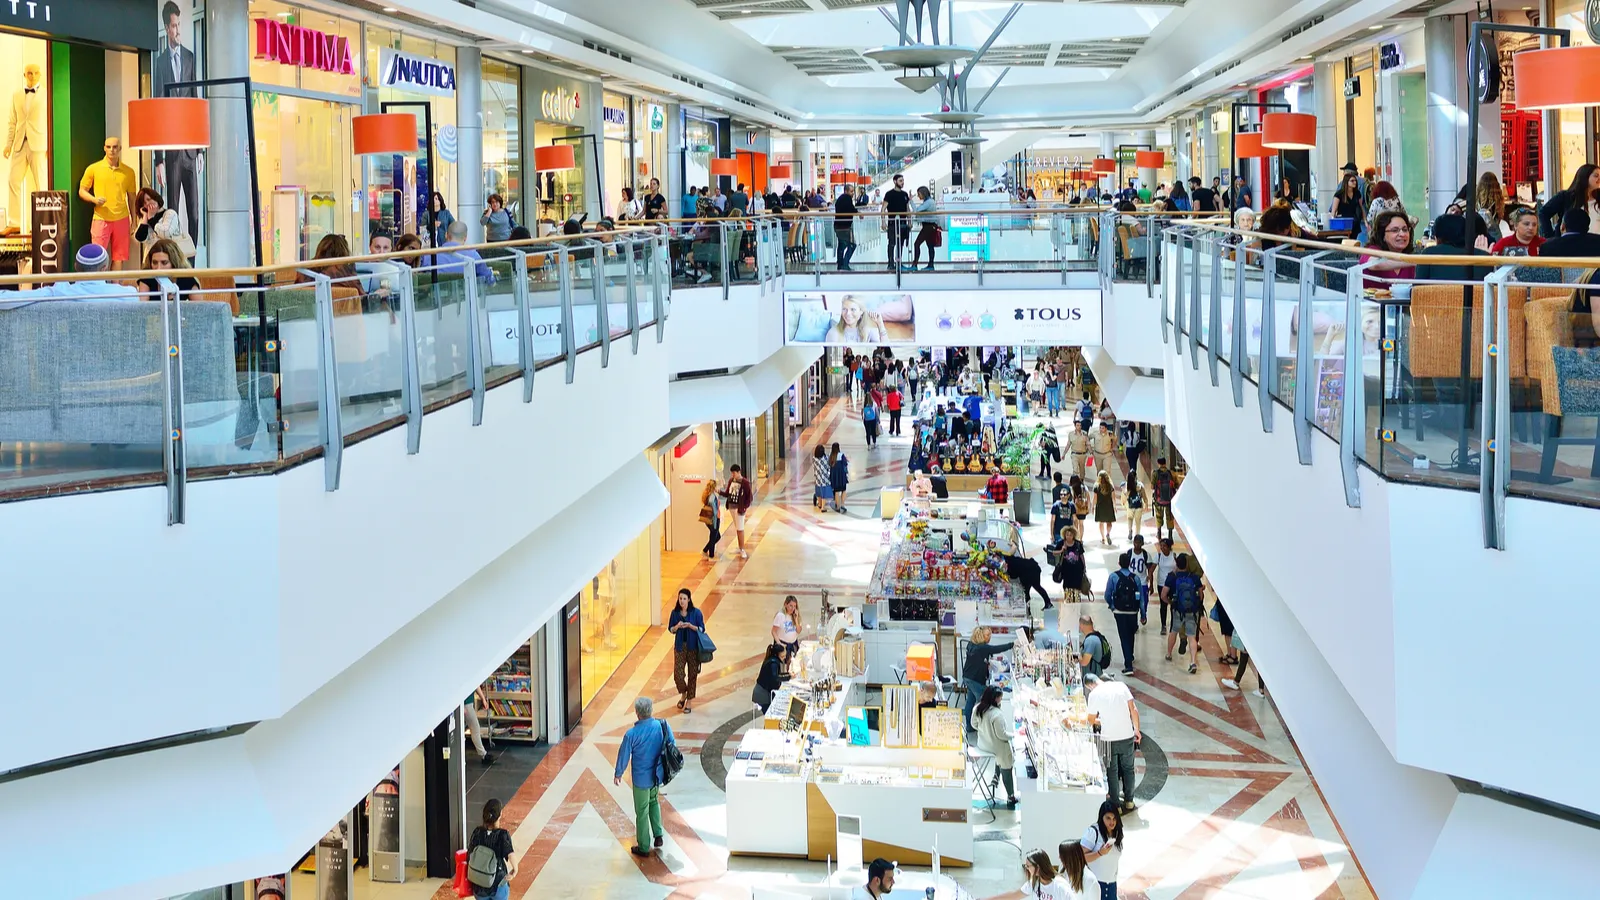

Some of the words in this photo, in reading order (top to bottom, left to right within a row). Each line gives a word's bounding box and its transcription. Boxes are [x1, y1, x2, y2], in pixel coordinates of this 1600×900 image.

[254, 18, 355, 75] INTIMA
[398, 56, 456, 90] NAUTICA
[1028, 155, 1069, 167] OREVER
[35, 196, 62, 204] MAX
[40, 223, 58, 284] POL
[1026, 308, 1082, 320] TOUS
[1130, 558, 1145, 574] 40
